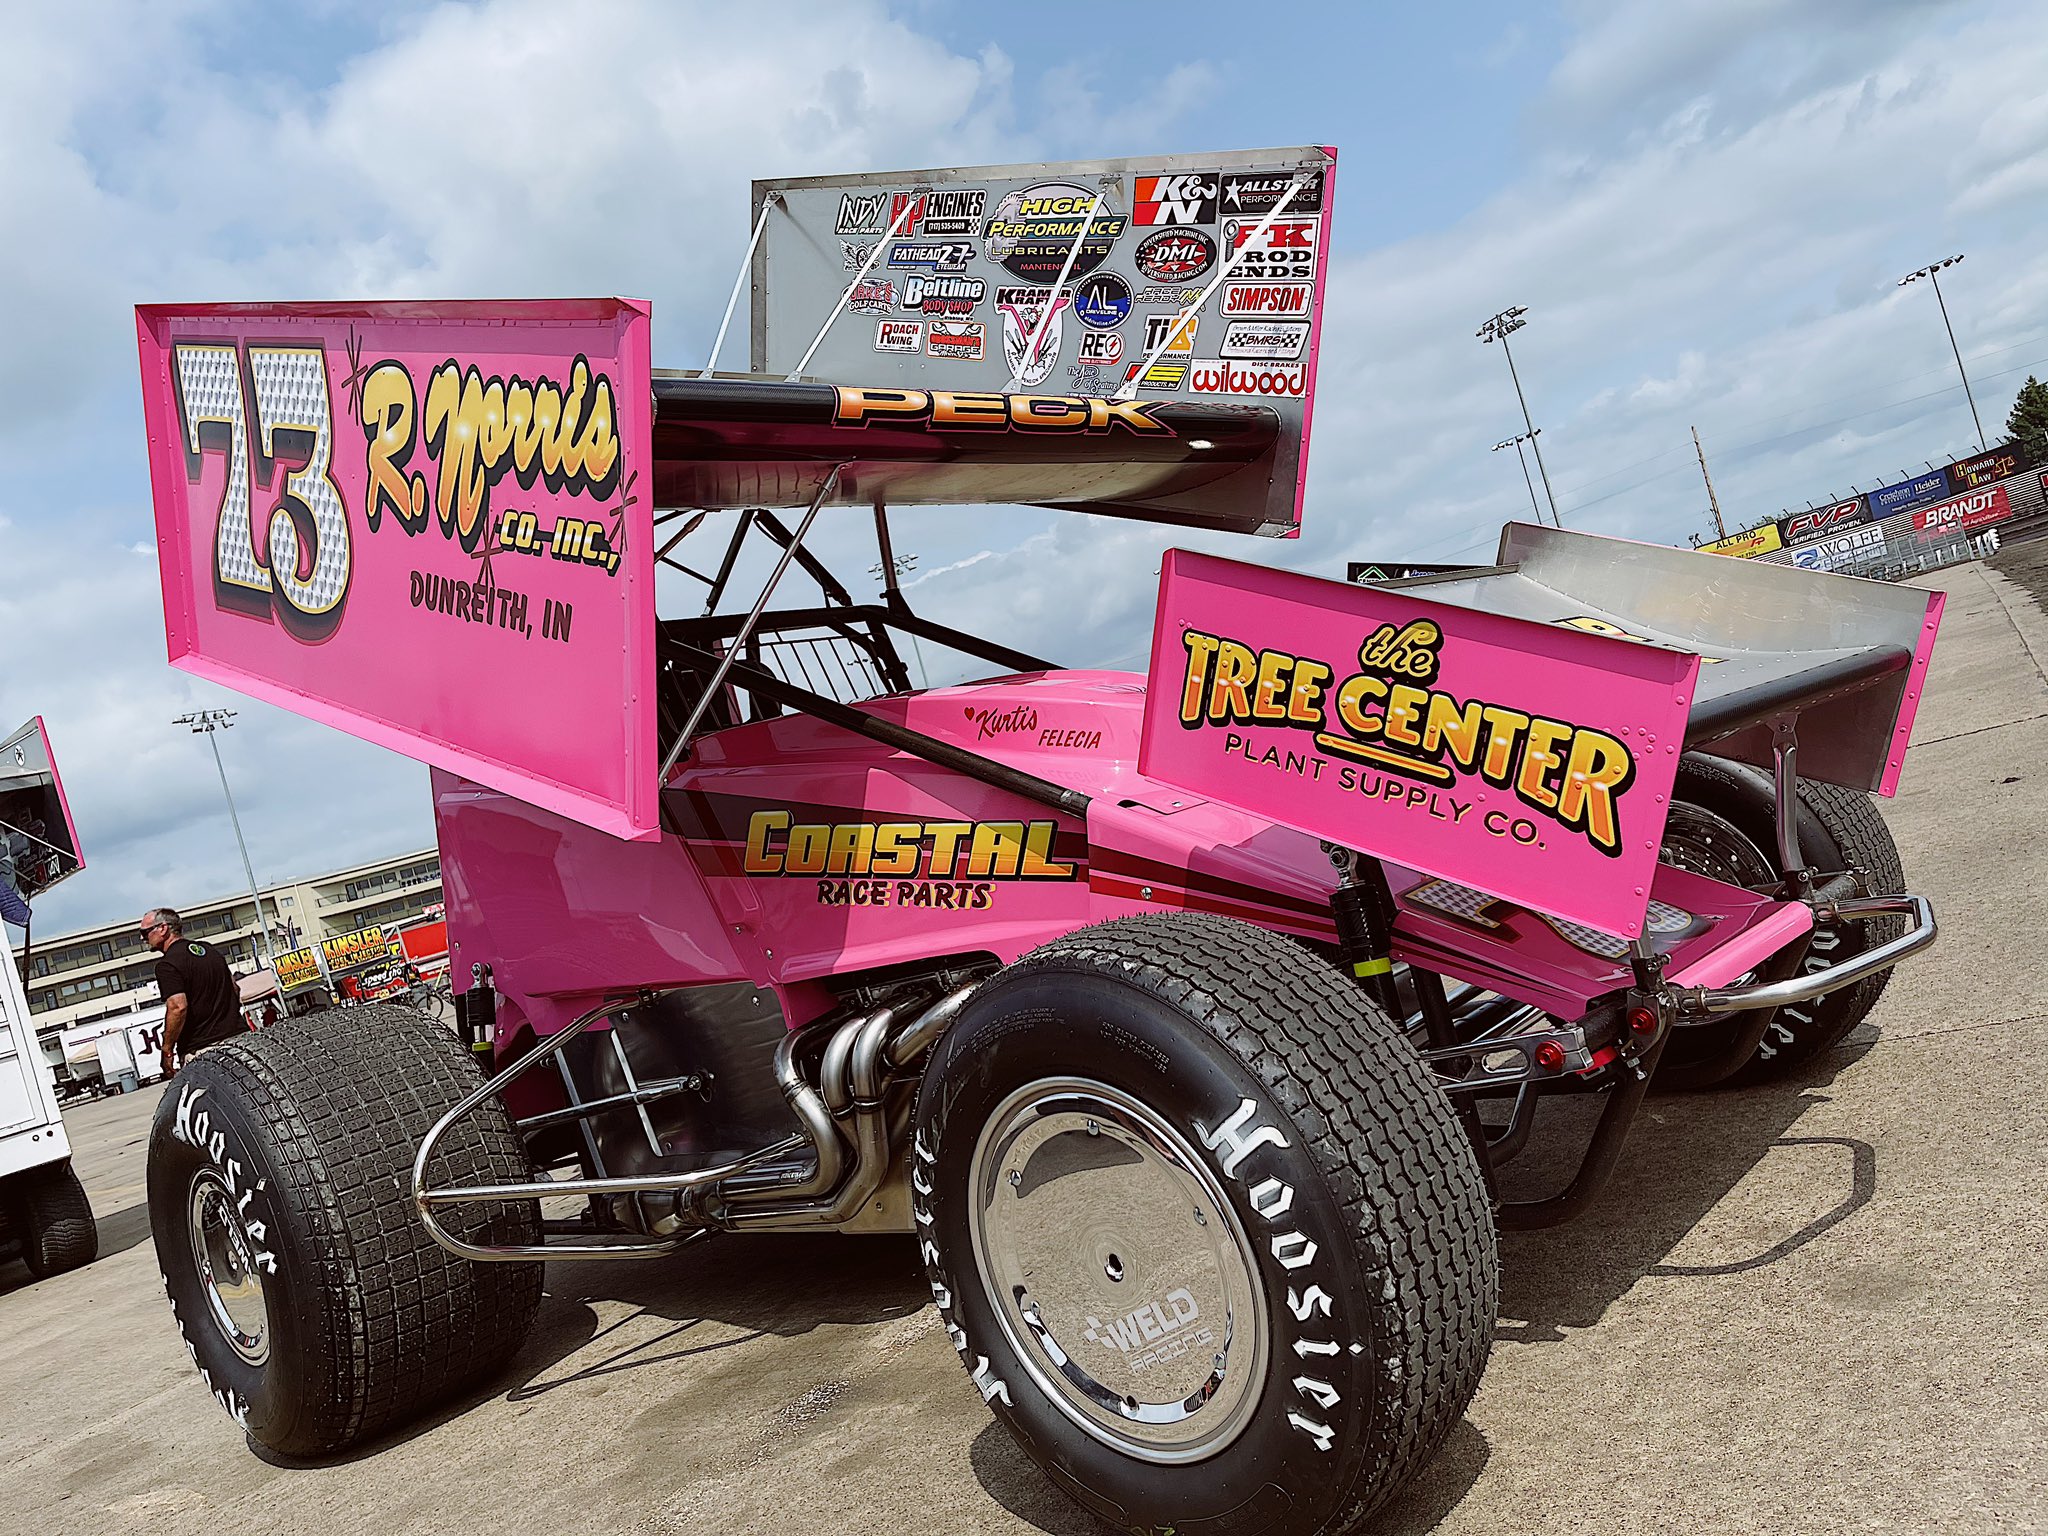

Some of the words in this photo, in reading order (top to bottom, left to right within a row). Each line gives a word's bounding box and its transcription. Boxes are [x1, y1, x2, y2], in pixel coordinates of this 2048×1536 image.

[1240, 179, 1318, 192] ALLSTR
[837, 194, 886, 229] INDY
[927, 192, 985, 217] ENGINES
[1020, 197, 1096, 214] HIGH
[989, 221, 1121, 237] PERFORMANCE
[1154, 244, 1197, 261] DMI
[1243, 251, 1312, 262] ROD
[1226, 265, 1310, 277] ENDS
[904, 277, 982, 305] Beltline
[997, 289, 1071, 303] KRAMR
[1227, 287, 1305, 311] SIMPSON
[850, 301, 868, 309] GOLF
[869, 301, 891, 312] CARTS
[923, 300, 946, 314] BODY
[948, 300, 973, 312] SHOP
[930, 344, 980, 354] GARAGE
[1246, 335, 1281, 345] BMRS
[1192, 361, 1307, 395] wilwood
[833, 385, 1177, 436] PECK
[362, 360, 428, 535] R.
[426, 357, 620, 546] Norris
[1956, 458, 1995, 477] HOWARD
[1968, 472, 1991, 487] LAW
[173, 342, 352, 630] 73
[1786, 498, 1861, 538] FVP
[1923, 490, 1997, 528] BRANDT
[499, 511, 541, 556] CO.
[551, 522, 621, 572] INC.,
[1716, 540, 1733, 549] ALL
[1736, 531, 1756, 543] PRO
[1789, 531, 1825, 545] VERIFIED.
[1828, 518, 1861, 534] PROVEN.
[410, 571, 533, 640] DUNREITH,
[543, 598, 573, 643] IN
[1360, 619, 1442, 682] the
[975, 705, 1039, 741] Kurtis
[1038, 729, 1102, 750] FELECIA
[1179, 629, 1334, 730] TREE
[1338, 673, 1636, 857] CENTER
[1224, 733, 1328, 783] PLANT
[1339, 767, 1474, 825] SUPPLY
[1483, 811, 1548, 851] CO.
[744, 810, 1080, 881] COASTAL
[817, 879, 889, 907] RACE
[897, 881, 996, 910] PARTS
[322, 927, 384, 960] KINSLER
[274, 948, 316, 975] KINSLER
[171, 1083, 278, 1276] Hoosier
[1192, 1096, 1366, 1452] Hoosier
[1106, 1287, 1200, 1353] WELD
[1130, 1326, 1215, 1374] RACING
